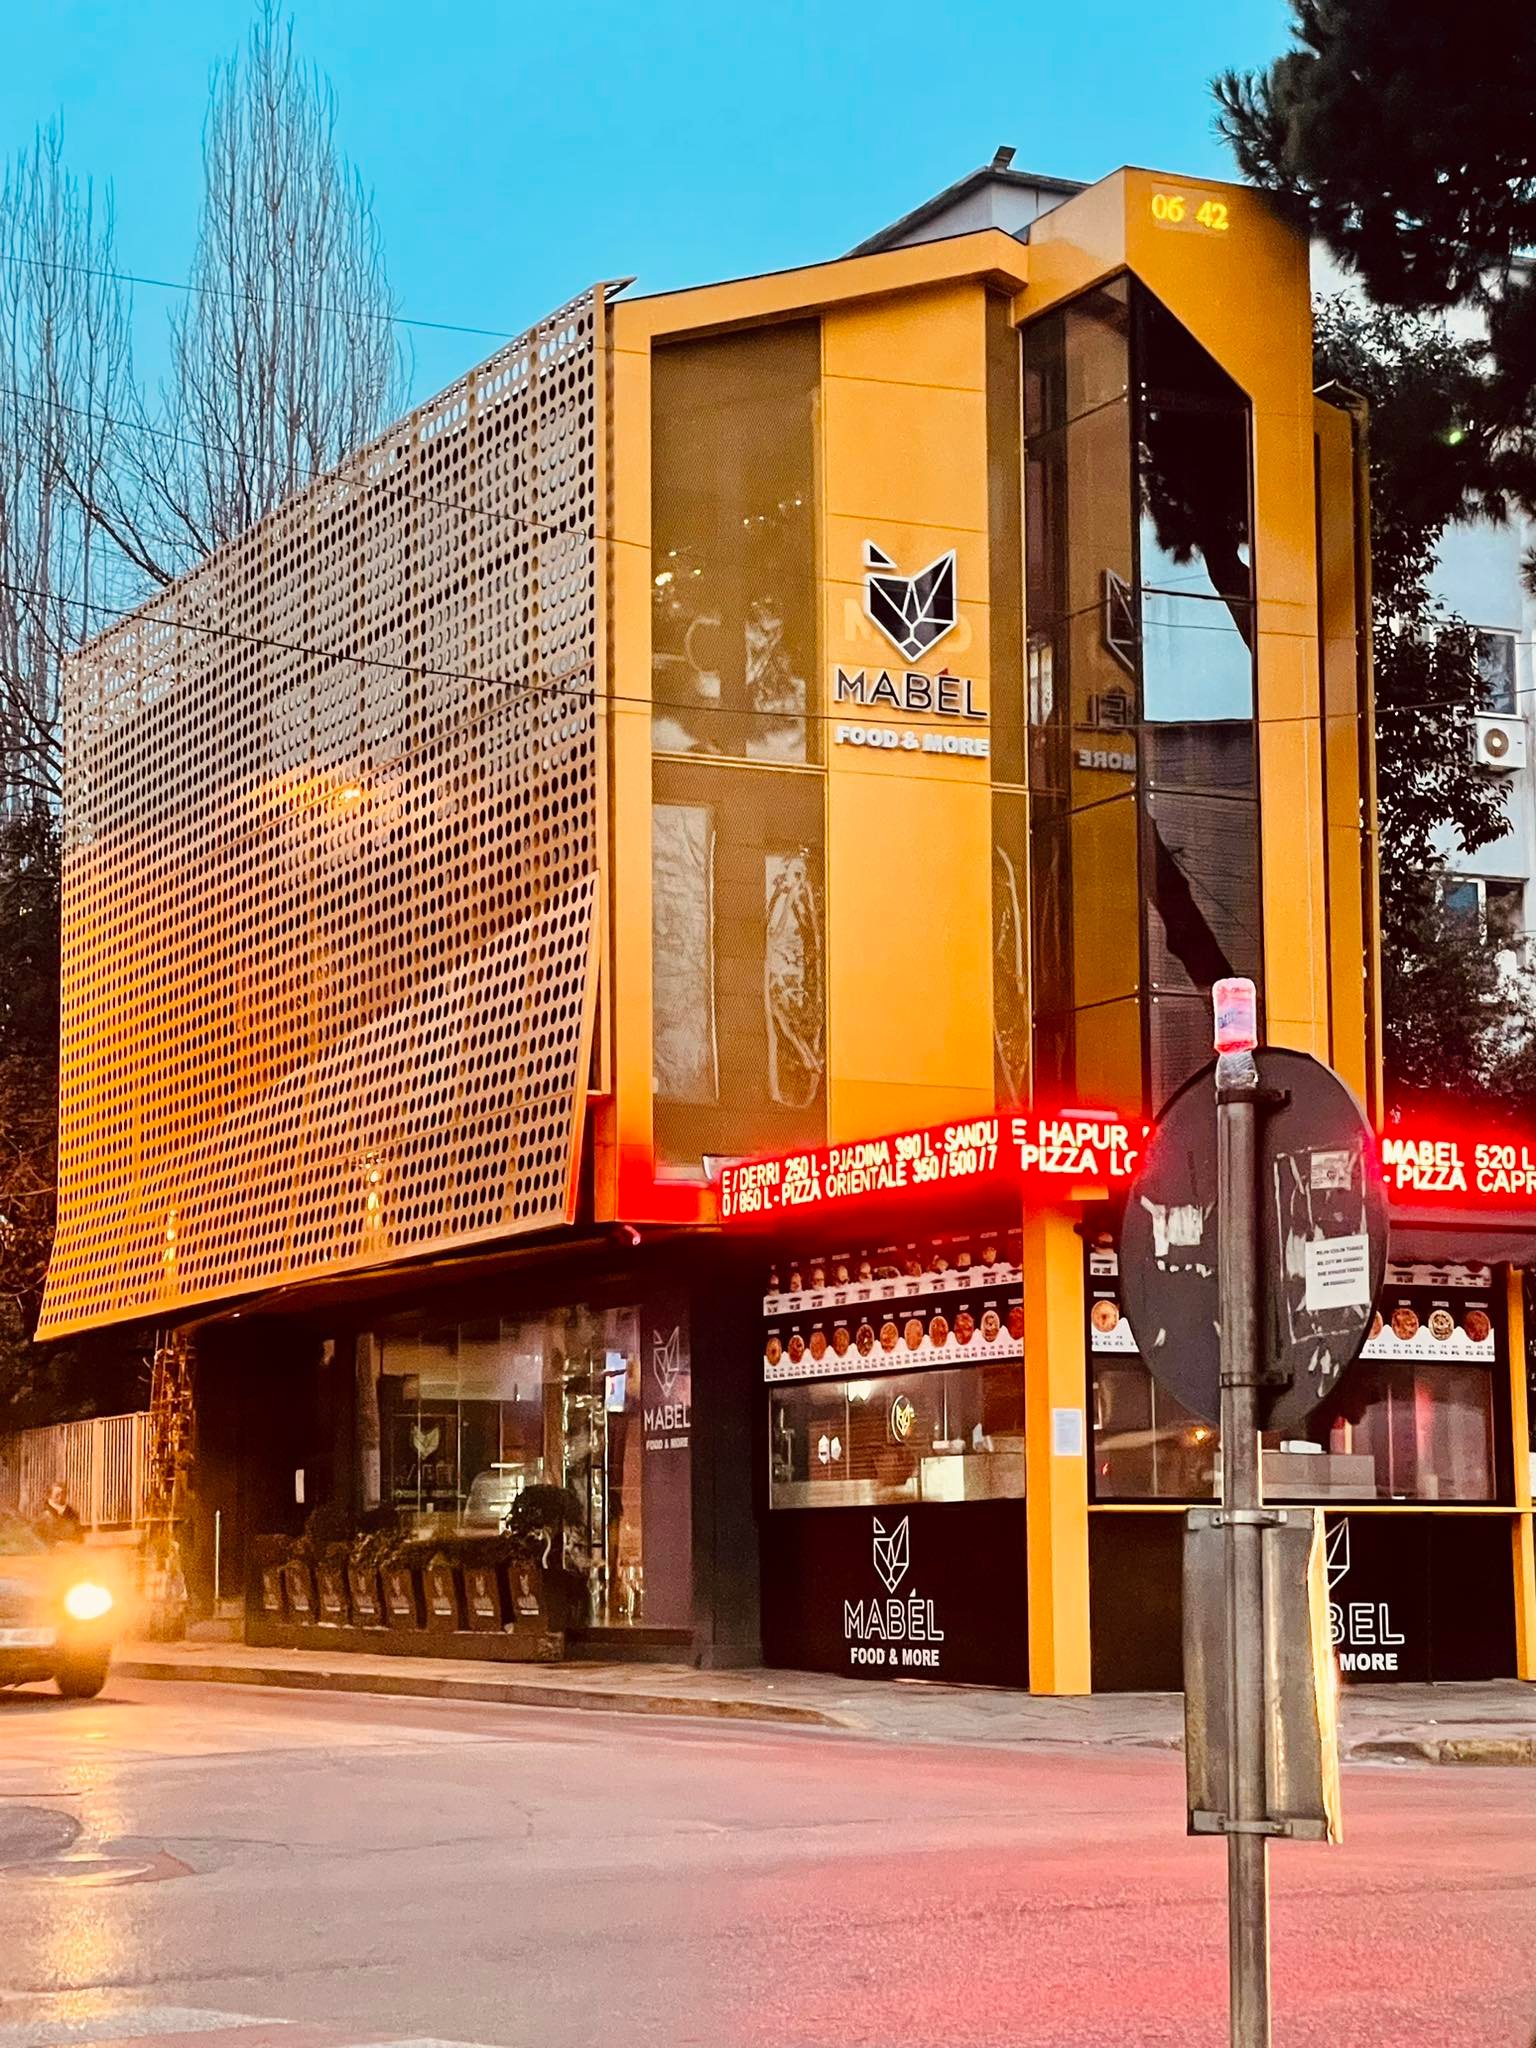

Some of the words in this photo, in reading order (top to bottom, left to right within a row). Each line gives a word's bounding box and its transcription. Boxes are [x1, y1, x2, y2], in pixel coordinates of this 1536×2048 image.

[1151, 193, 1184, 222] 06
[1195, 201, 1229, 230] 42
[835, 725, 899, 748] FOOD
[900, 730, 920, 749] &
[922, 733, 990, 758] MORE
[784, 1155, 809, 1182] 250
[943, 1118, 999, 1152] SANDU
[1039, 1120, 1129, 1151] HAPUR
[1021, 1144, 1099, 1175] PIZZA
[1382, 1138, 1465, 1168] MABEL
[1475, 1143, 1517, 1170] 520
[781, 1177, 822, 1207] PIZZA
[825, 1161, 908, 1198] ORIENTALE
[1396, 1164, 1468, 1191] PIZZA
[1329, 1602, 1406, 1646] BEL
[850, 1647, 886, 1665] FOOD
[888, 1648, 899, 1666] &
[901, 1648, 940, 1667] MORE
[1339, 1652, 1399, 1672] MORE
